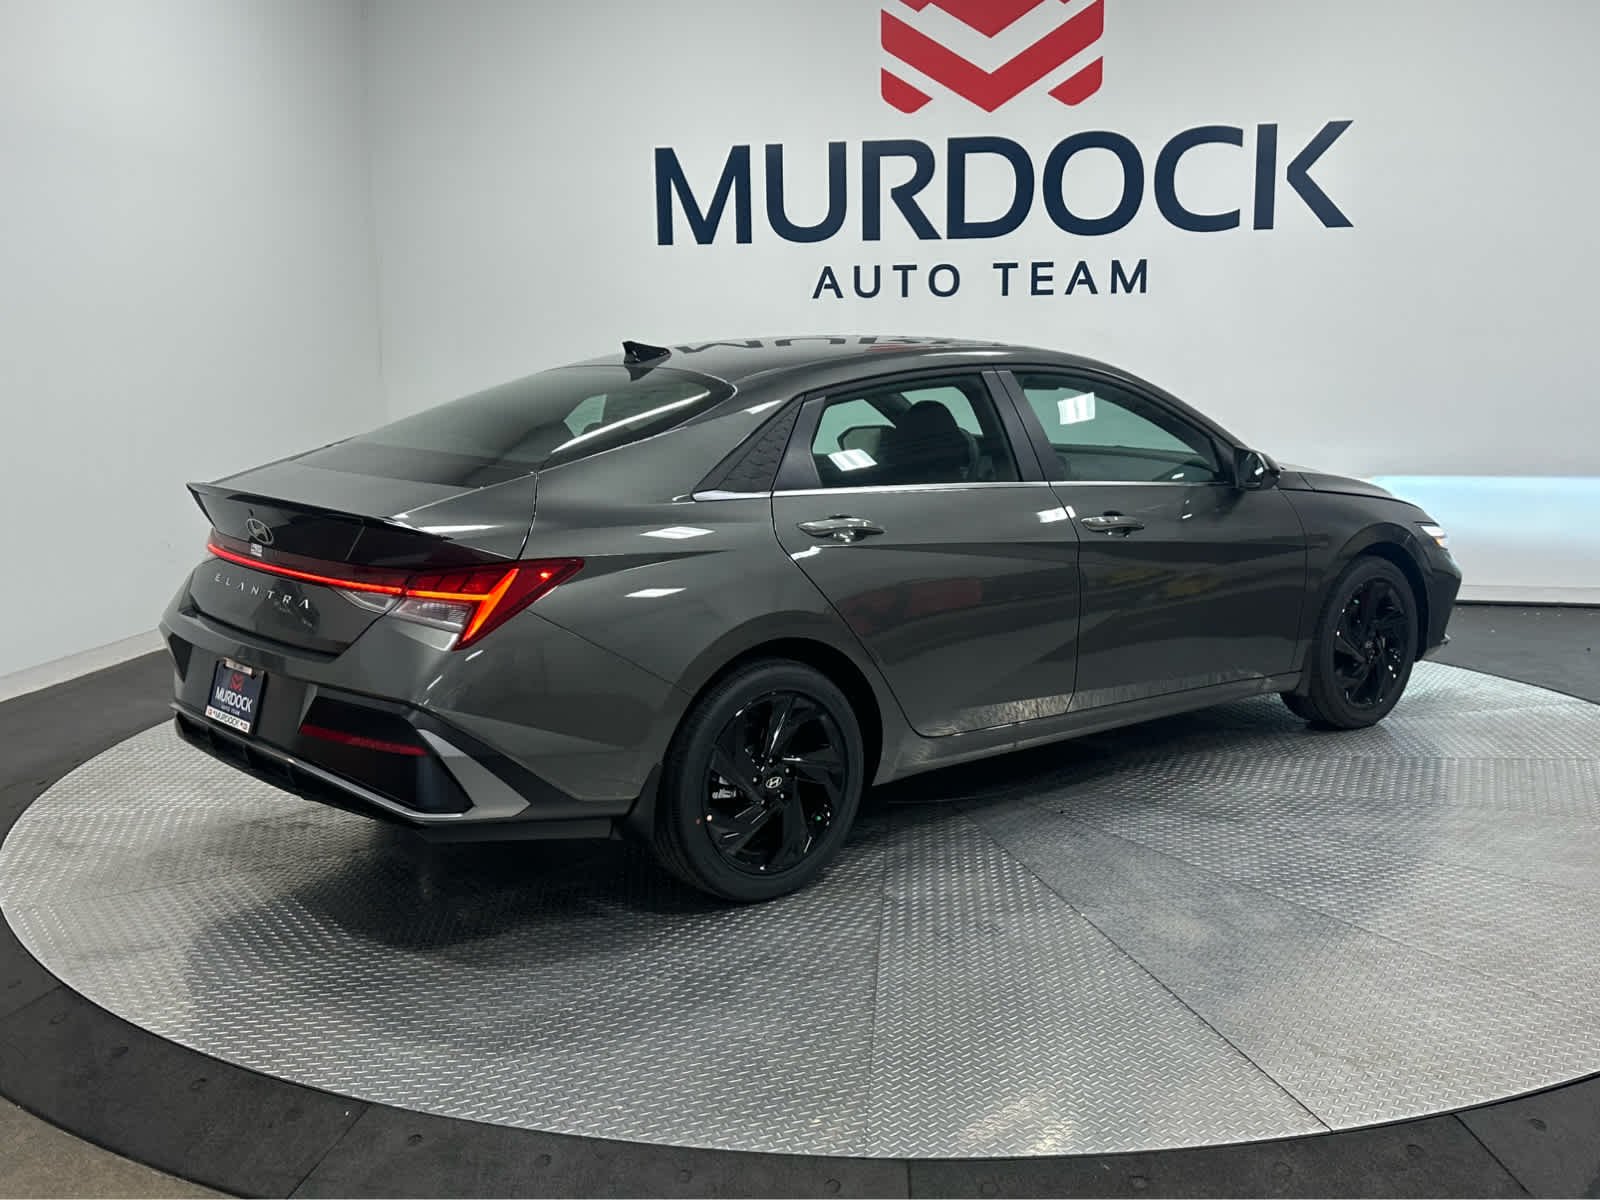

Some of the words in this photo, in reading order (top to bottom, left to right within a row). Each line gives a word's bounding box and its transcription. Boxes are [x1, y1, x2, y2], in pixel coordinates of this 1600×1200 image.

[654, 120, 1354, 246] MURDOCK
[812, 263, 961, 299] AUTO
[992, 258, 1149, 297] TEAM
[214, 573, 309, 609] ELANTRA
[215, 686, 253, 713] MURDOCK
